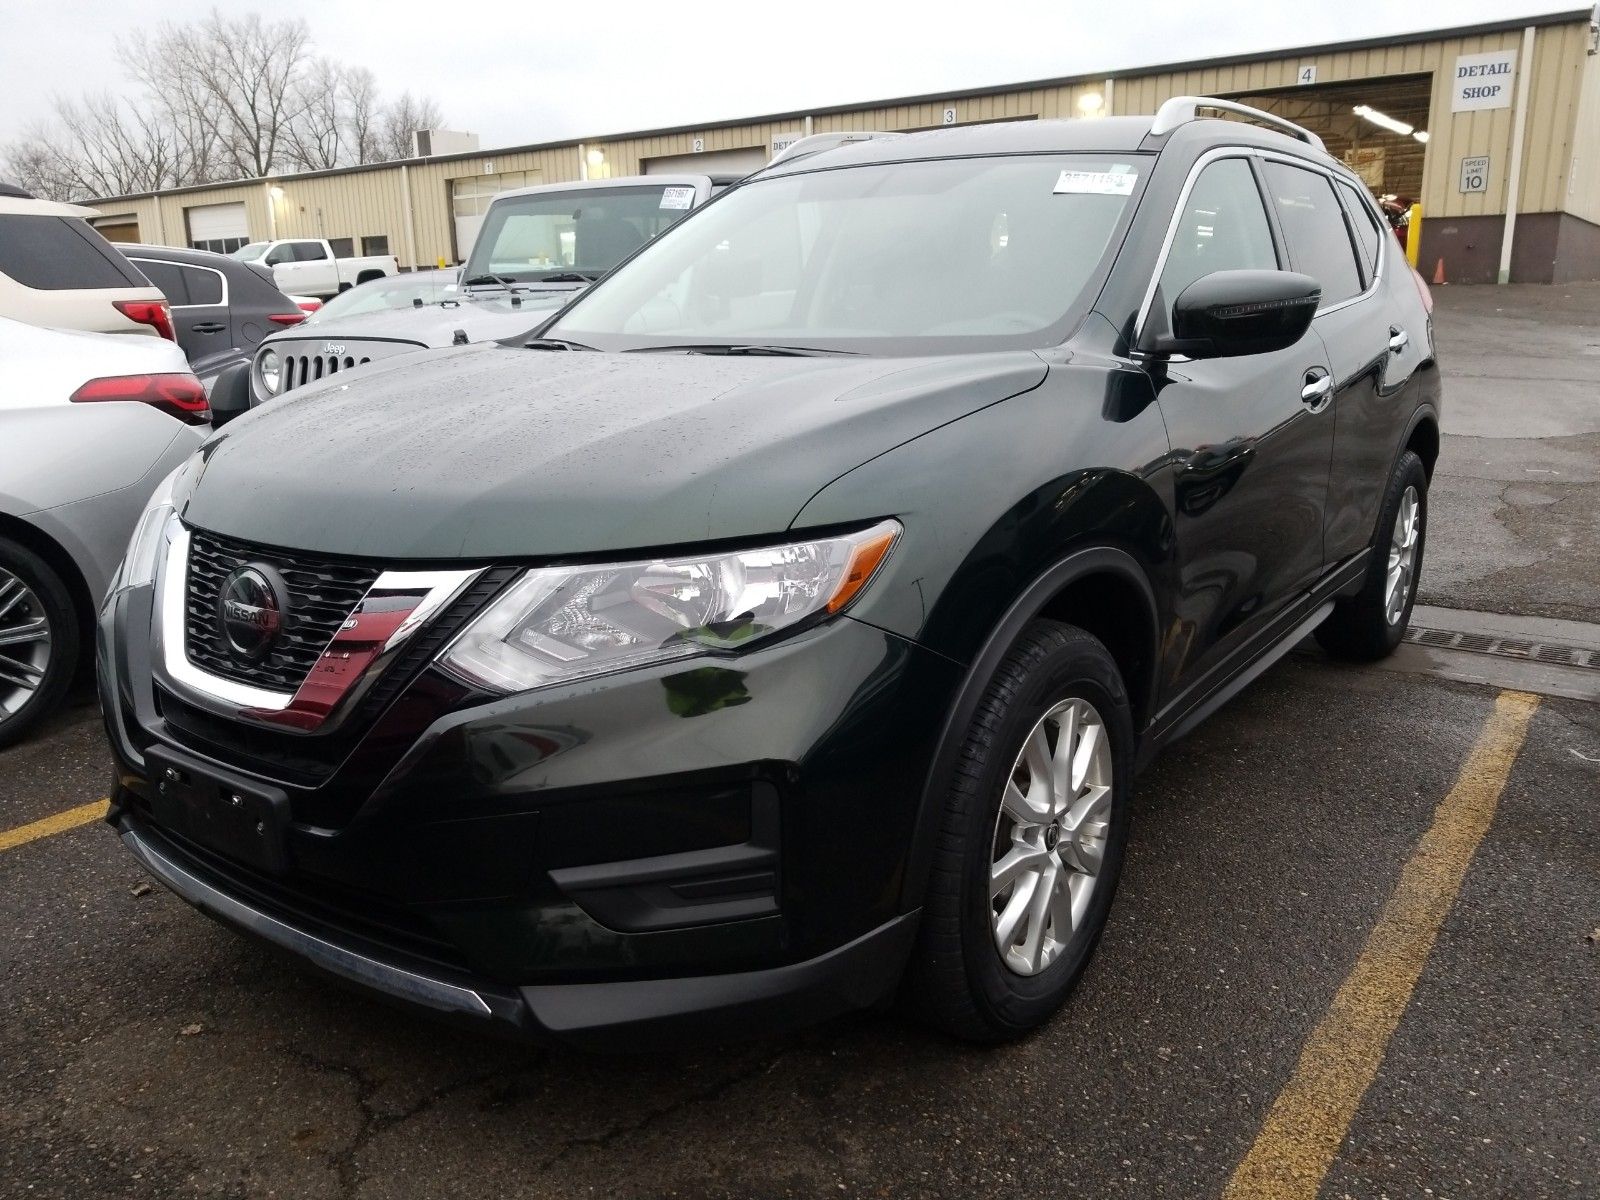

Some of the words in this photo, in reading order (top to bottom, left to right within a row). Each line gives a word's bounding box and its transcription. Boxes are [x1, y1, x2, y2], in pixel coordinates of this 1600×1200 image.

[1302, 68, 1311, 82] 4
[1457, 63, 1511, 77] DETAIL
[1462, 85, 1501, 99] SHOP
[946, 110, 953, 123] 3
[695, 140, 702, 151] 2
[773, 140, 796, 151] DET
[1465, 175, 1482, 189] 10
[324, 342, 346, 356] Jeep
[224, 602, 270, 624] NISSAN
